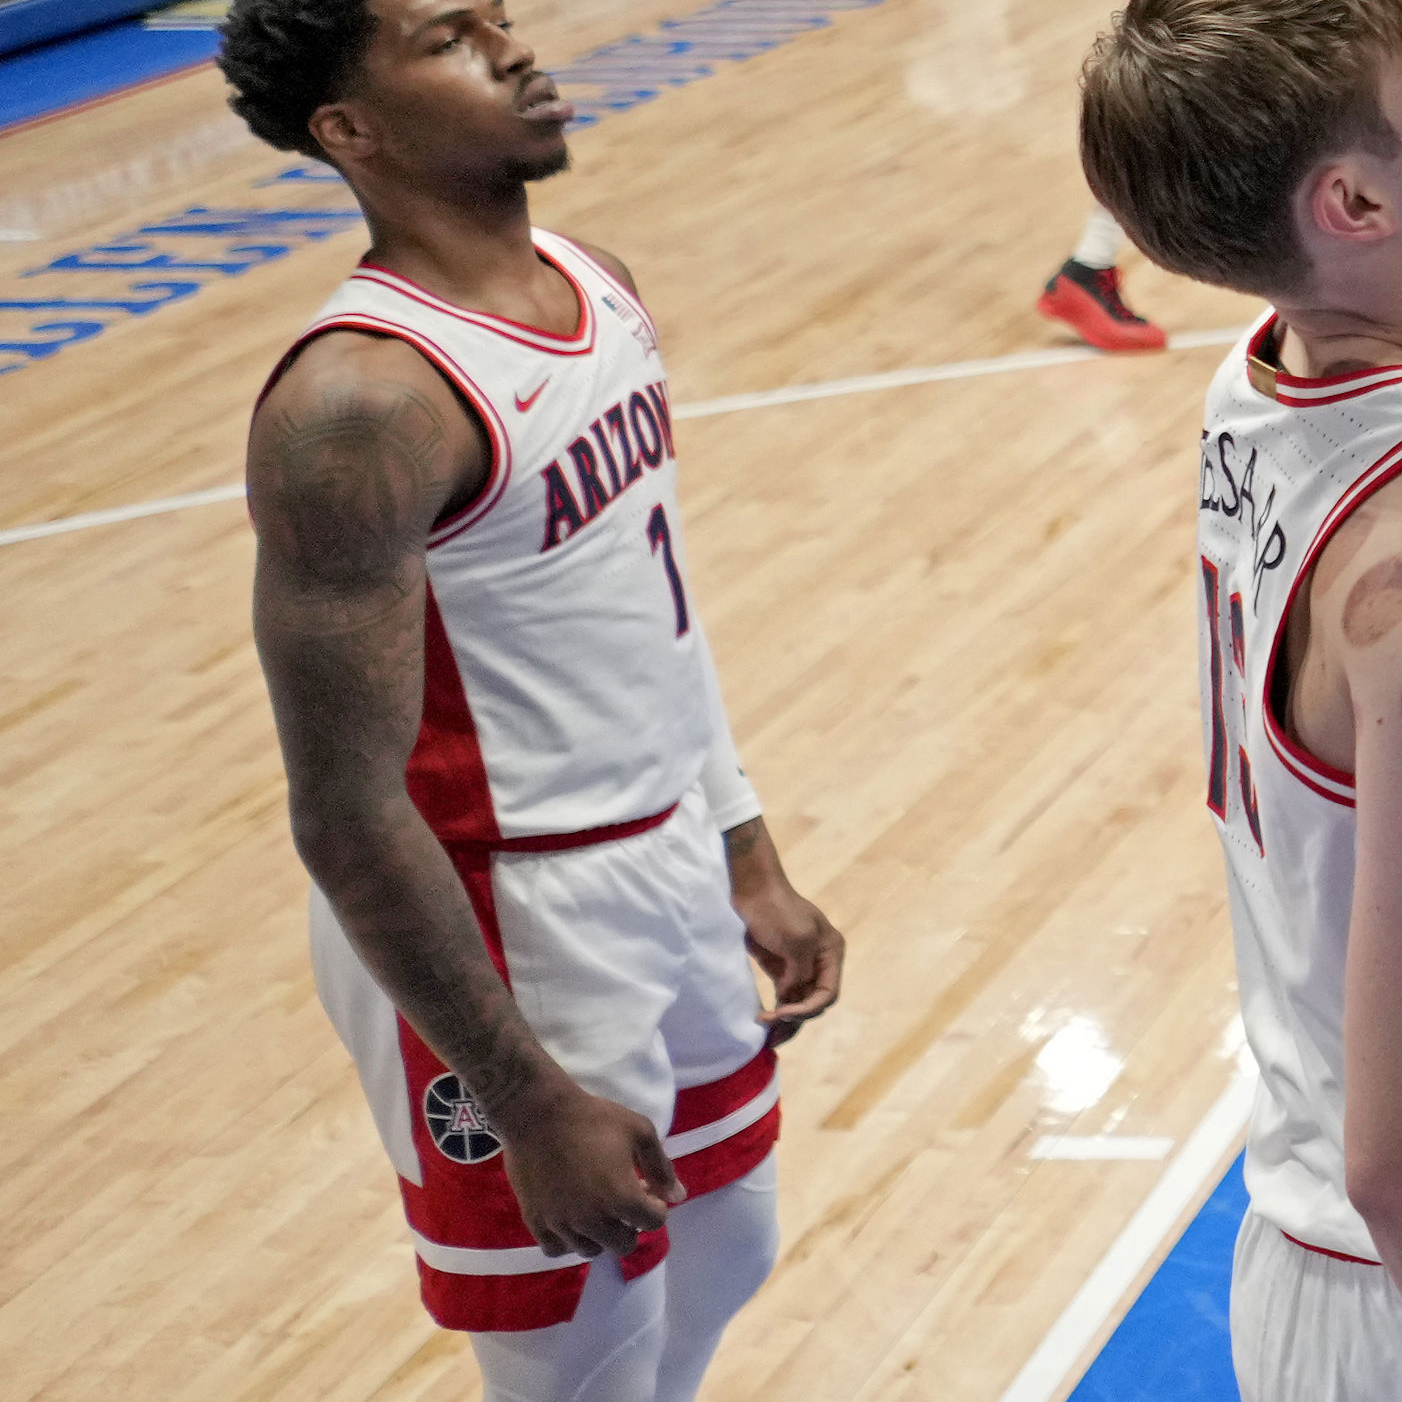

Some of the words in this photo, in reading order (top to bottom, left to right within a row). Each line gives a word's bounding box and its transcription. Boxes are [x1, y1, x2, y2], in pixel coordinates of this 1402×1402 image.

[540, 380, 677, 555] ARIZON
[645, 501, 690, 639] 1
[446, 1098, 485, 1133] A
